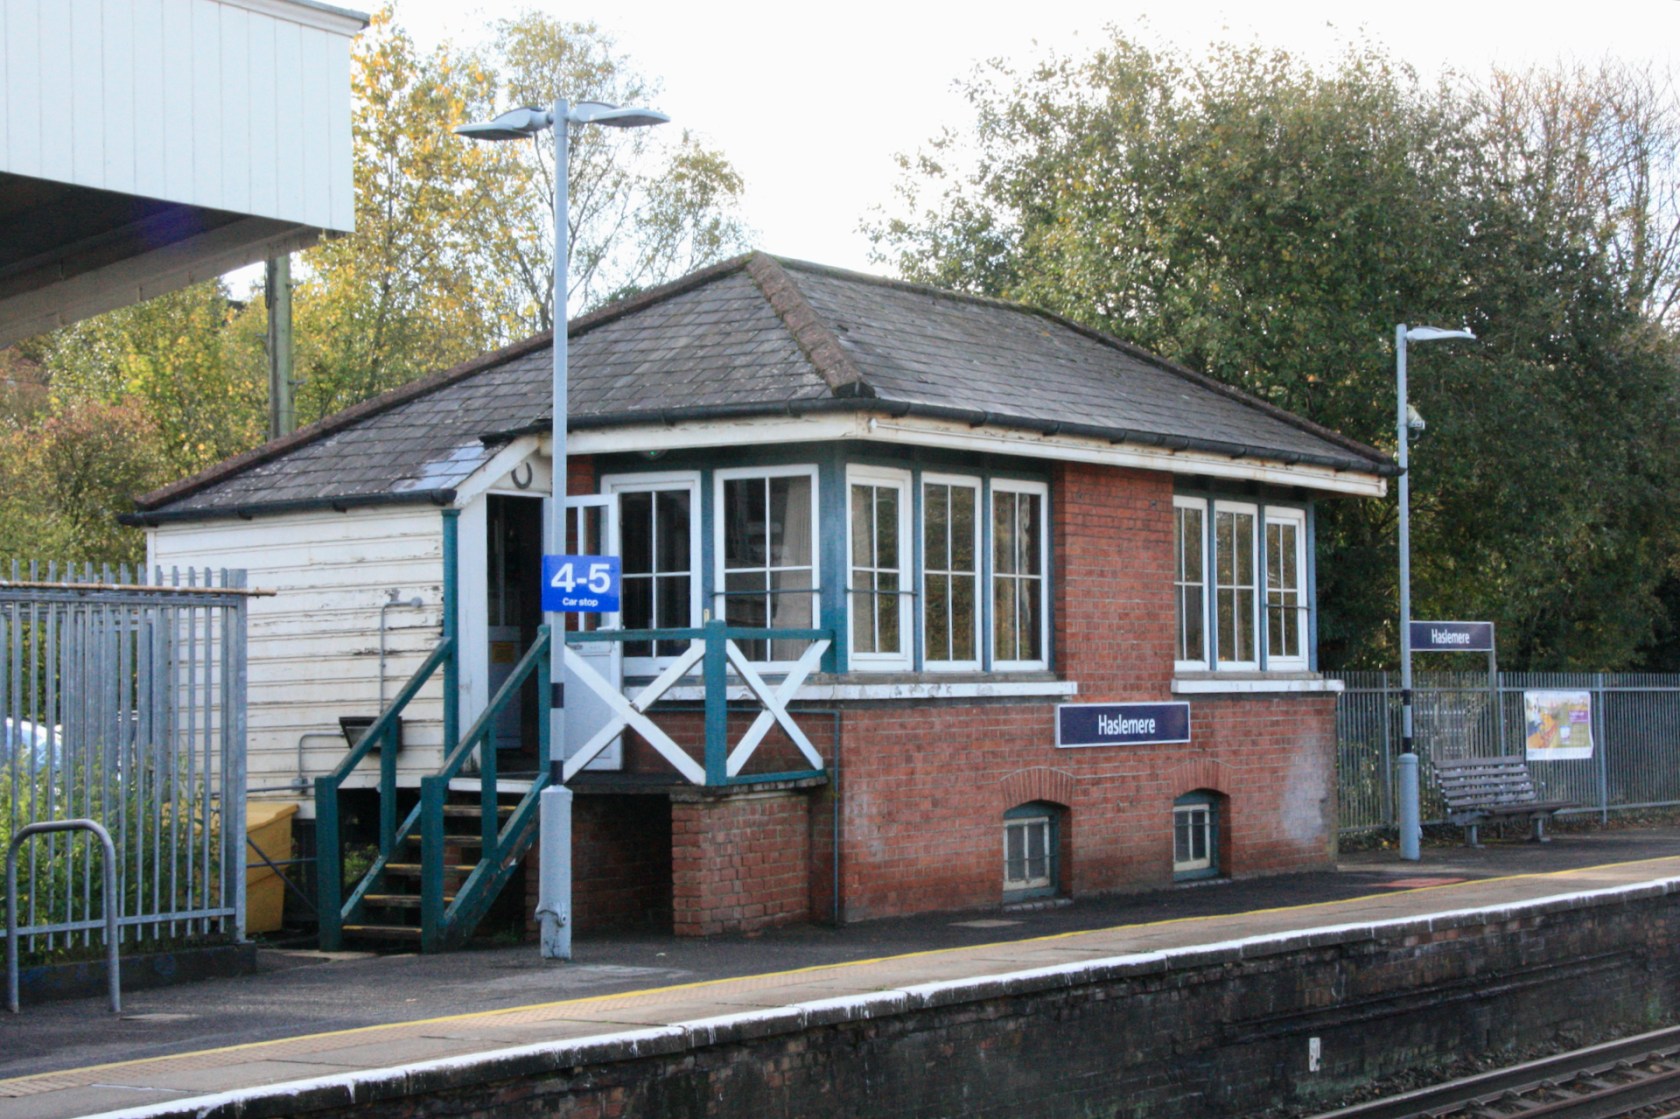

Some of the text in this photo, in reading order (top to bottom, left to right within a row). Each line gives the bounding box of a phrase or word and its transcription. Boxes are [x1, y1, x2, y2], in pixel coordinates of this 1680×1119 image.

[551, 563, 611, 594] 4-5
[562, 597, 599, 607] Car stop
[1431, 628, 1470, 644] Haslemere
[1098, 713, 1155, 735] Haslemere
